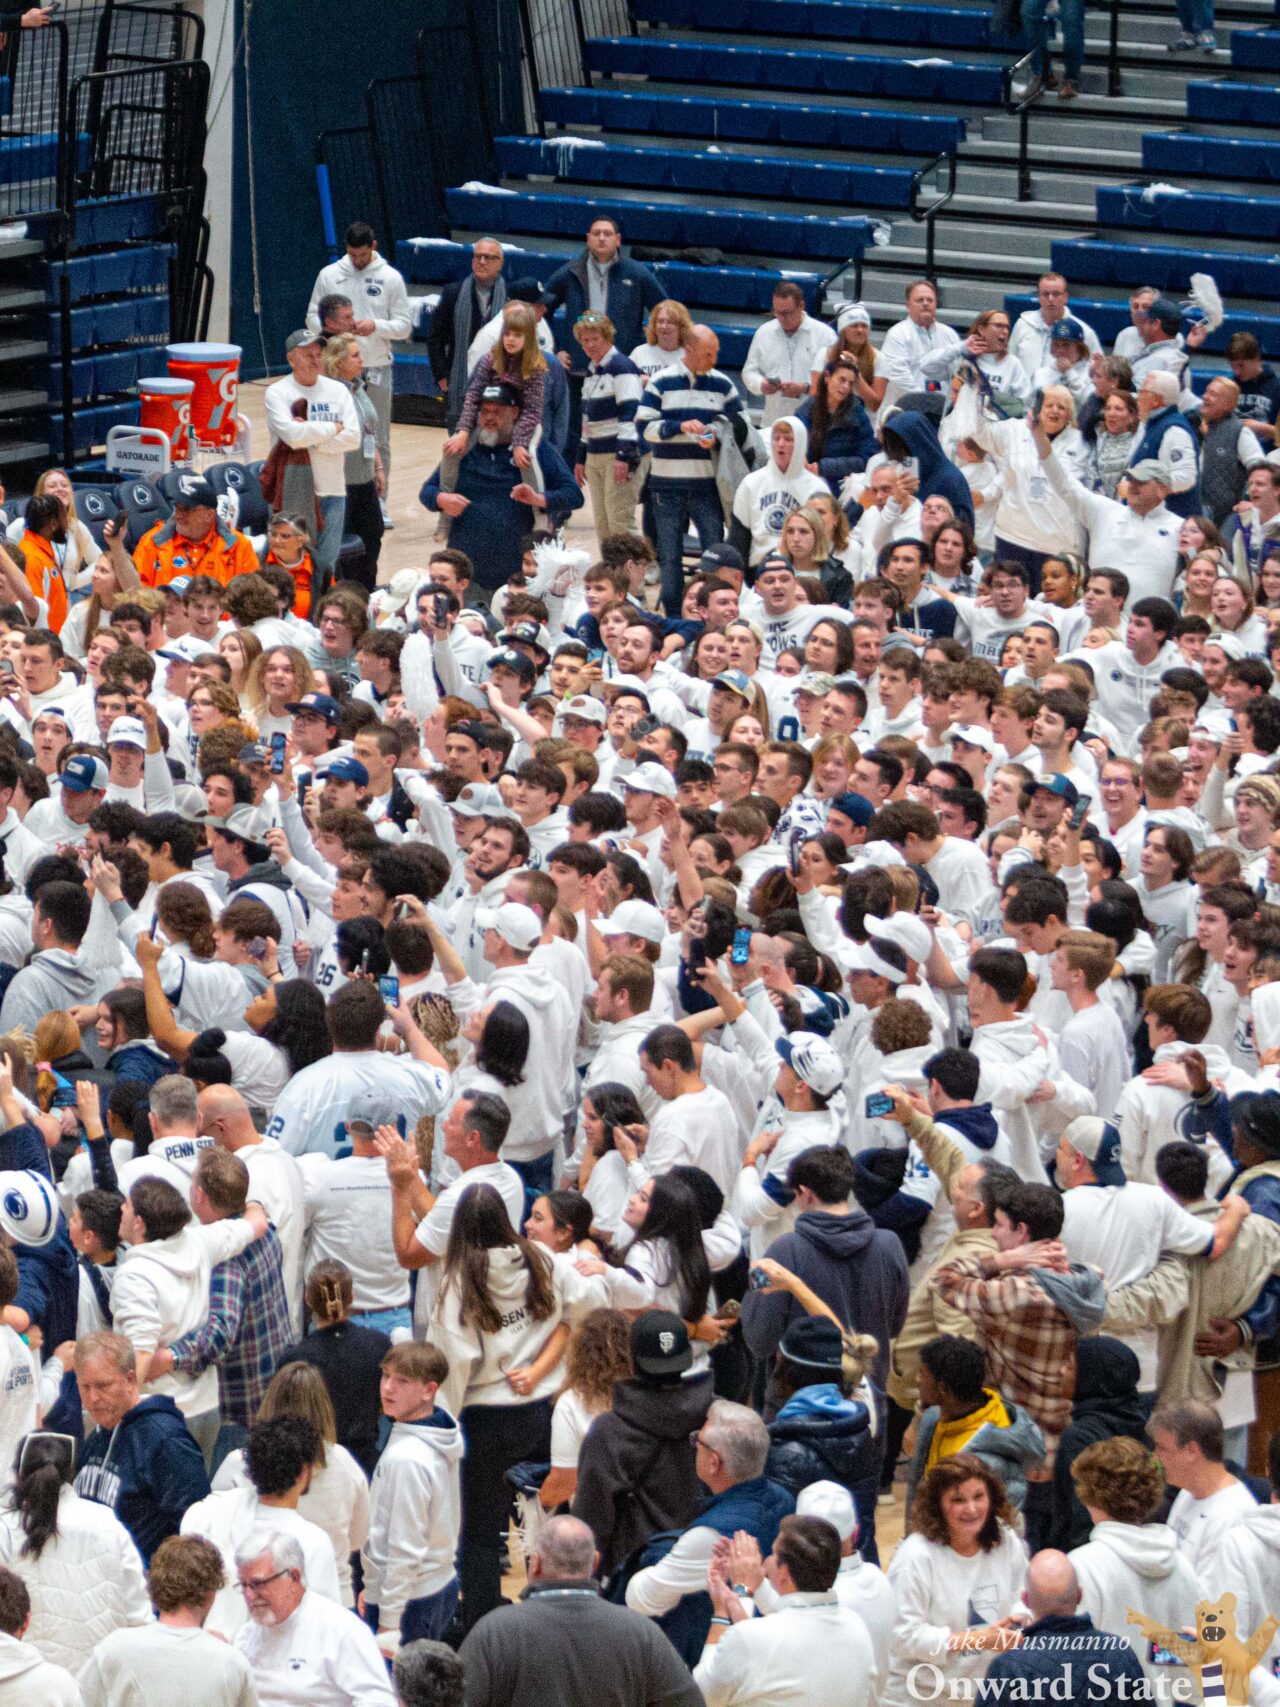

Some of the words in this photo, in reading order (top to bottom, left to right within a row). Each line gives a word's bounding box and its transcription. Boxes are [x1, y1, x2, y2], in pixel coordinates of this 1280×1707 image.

[218, 371, 237, 402] G
[177, 403, 189, 424] G
[116, 450, 160, 463] GATORADE
[760, 491, 778, 511] PENN
[460, 663, 476, 683] TE
[165, 1141, 195, 1162] PENN
